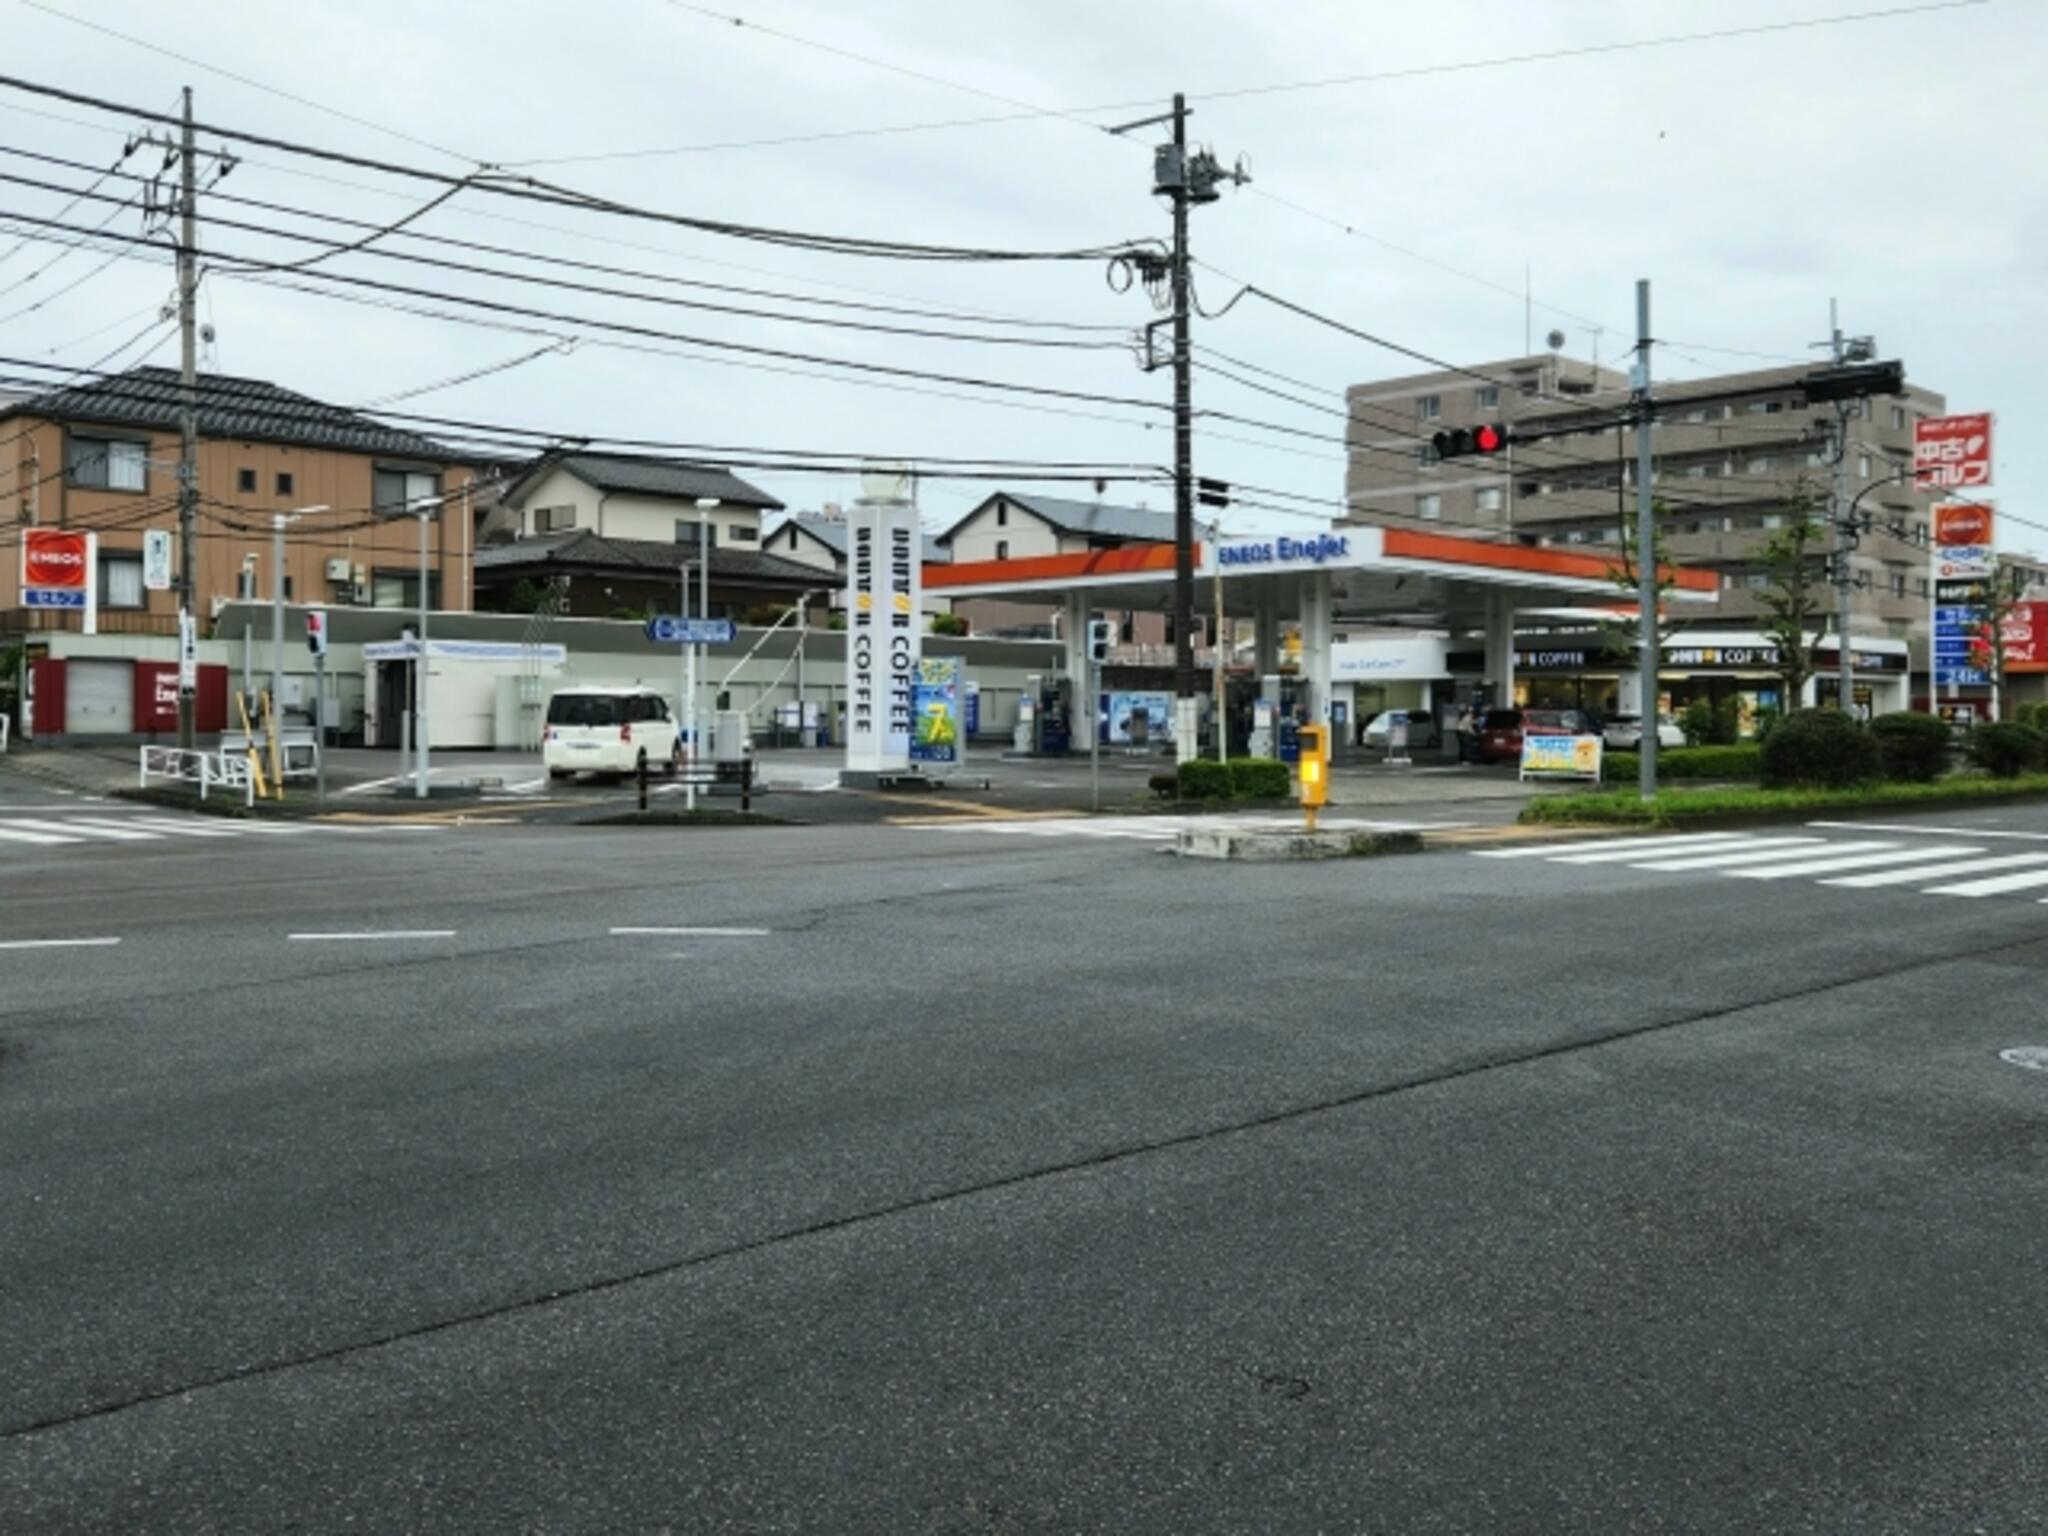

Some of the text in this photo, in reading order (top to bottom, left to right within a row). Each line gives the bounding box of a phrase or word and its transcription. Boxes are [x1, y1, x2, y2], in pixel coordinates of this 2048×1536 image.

[1219, 544, 1273, 565] ENEOS
[855, 633, 872, 734] COFFEE
[891, 635, 911, 735] COFFEE
